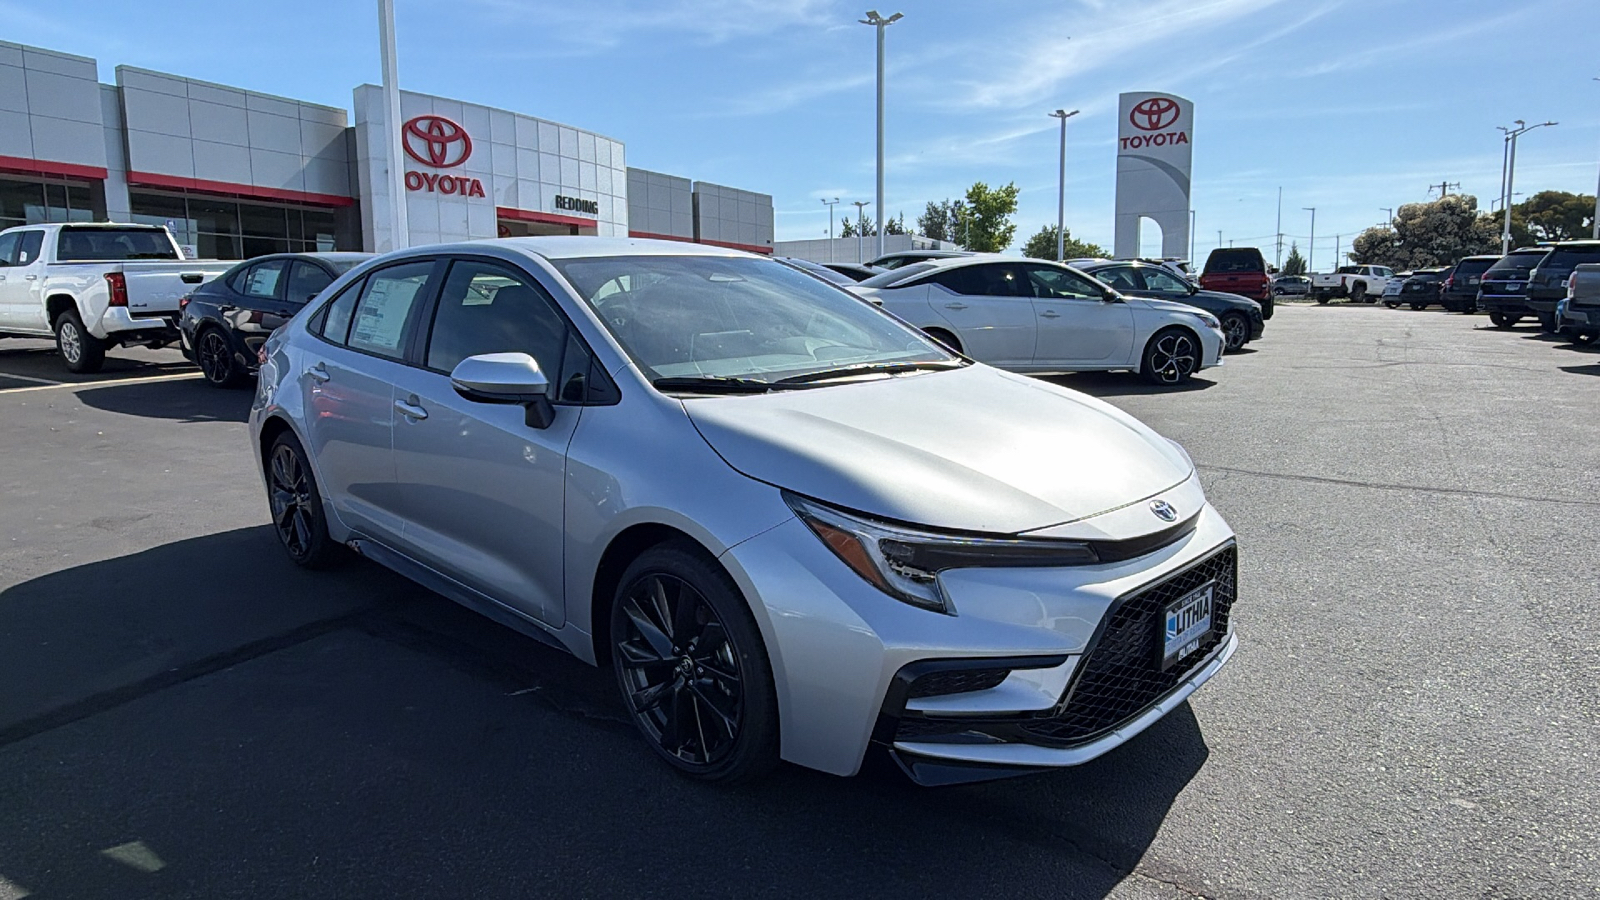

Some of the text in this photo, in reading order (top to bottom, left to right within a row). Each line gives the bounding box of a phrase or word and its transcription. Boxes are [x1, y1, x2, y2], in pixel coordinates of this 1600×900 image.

[1120, 132, 1188, 149] TOYOTA
[405, 171, 485, 197] OYOTA
[555, 195, 598, 214] REDDING
[1176, 596, 1210, 635] LITHIA
